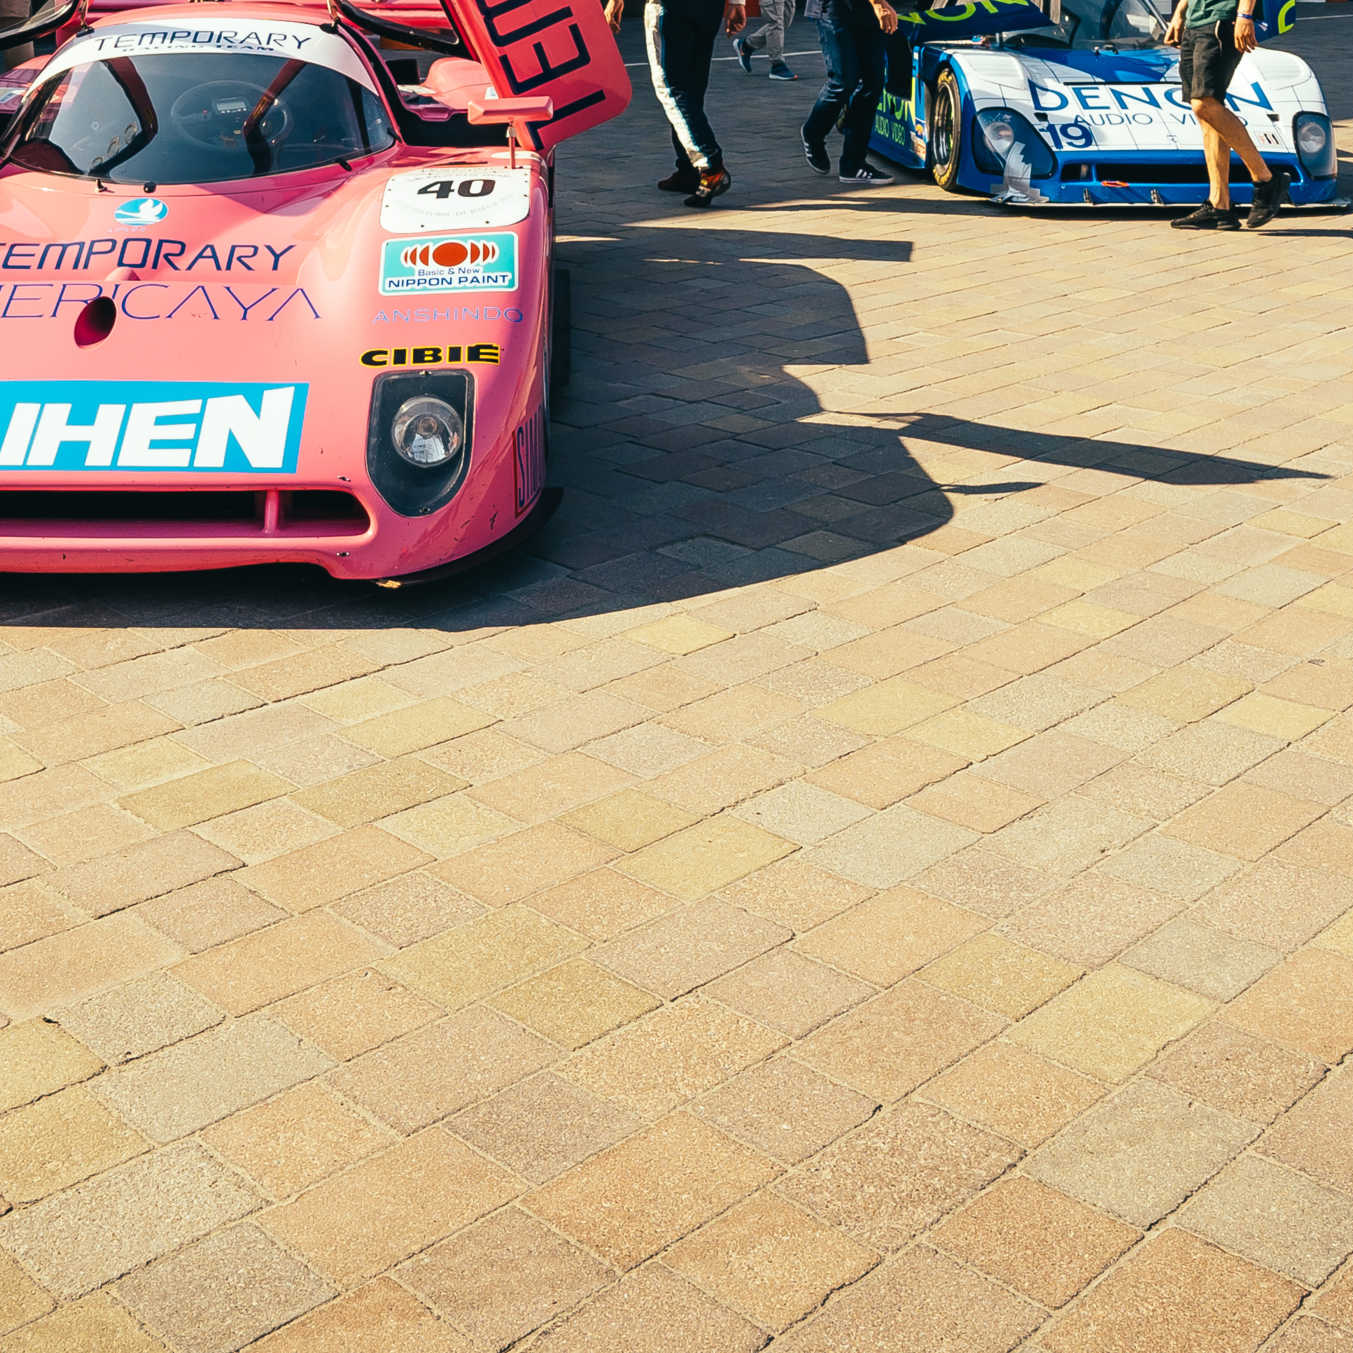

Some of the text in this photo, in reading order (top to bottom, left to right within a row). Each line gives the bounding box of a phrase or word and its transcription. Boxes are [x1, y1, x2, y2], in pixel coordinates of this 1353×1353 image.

[95, 31, 312, 52] TEMPORARY
[1072, 113, 1153, 127] AUDIO
[1039, 122, 1093, 150] 19
[417, 179, 496, 199] 40
[388, 274, 509, 288] NIPPON PAINT
[418, 269, 444, 277] Basic
[448, 267, 455, 275] &
[372, 306, 524, 325] ANSHINDO
